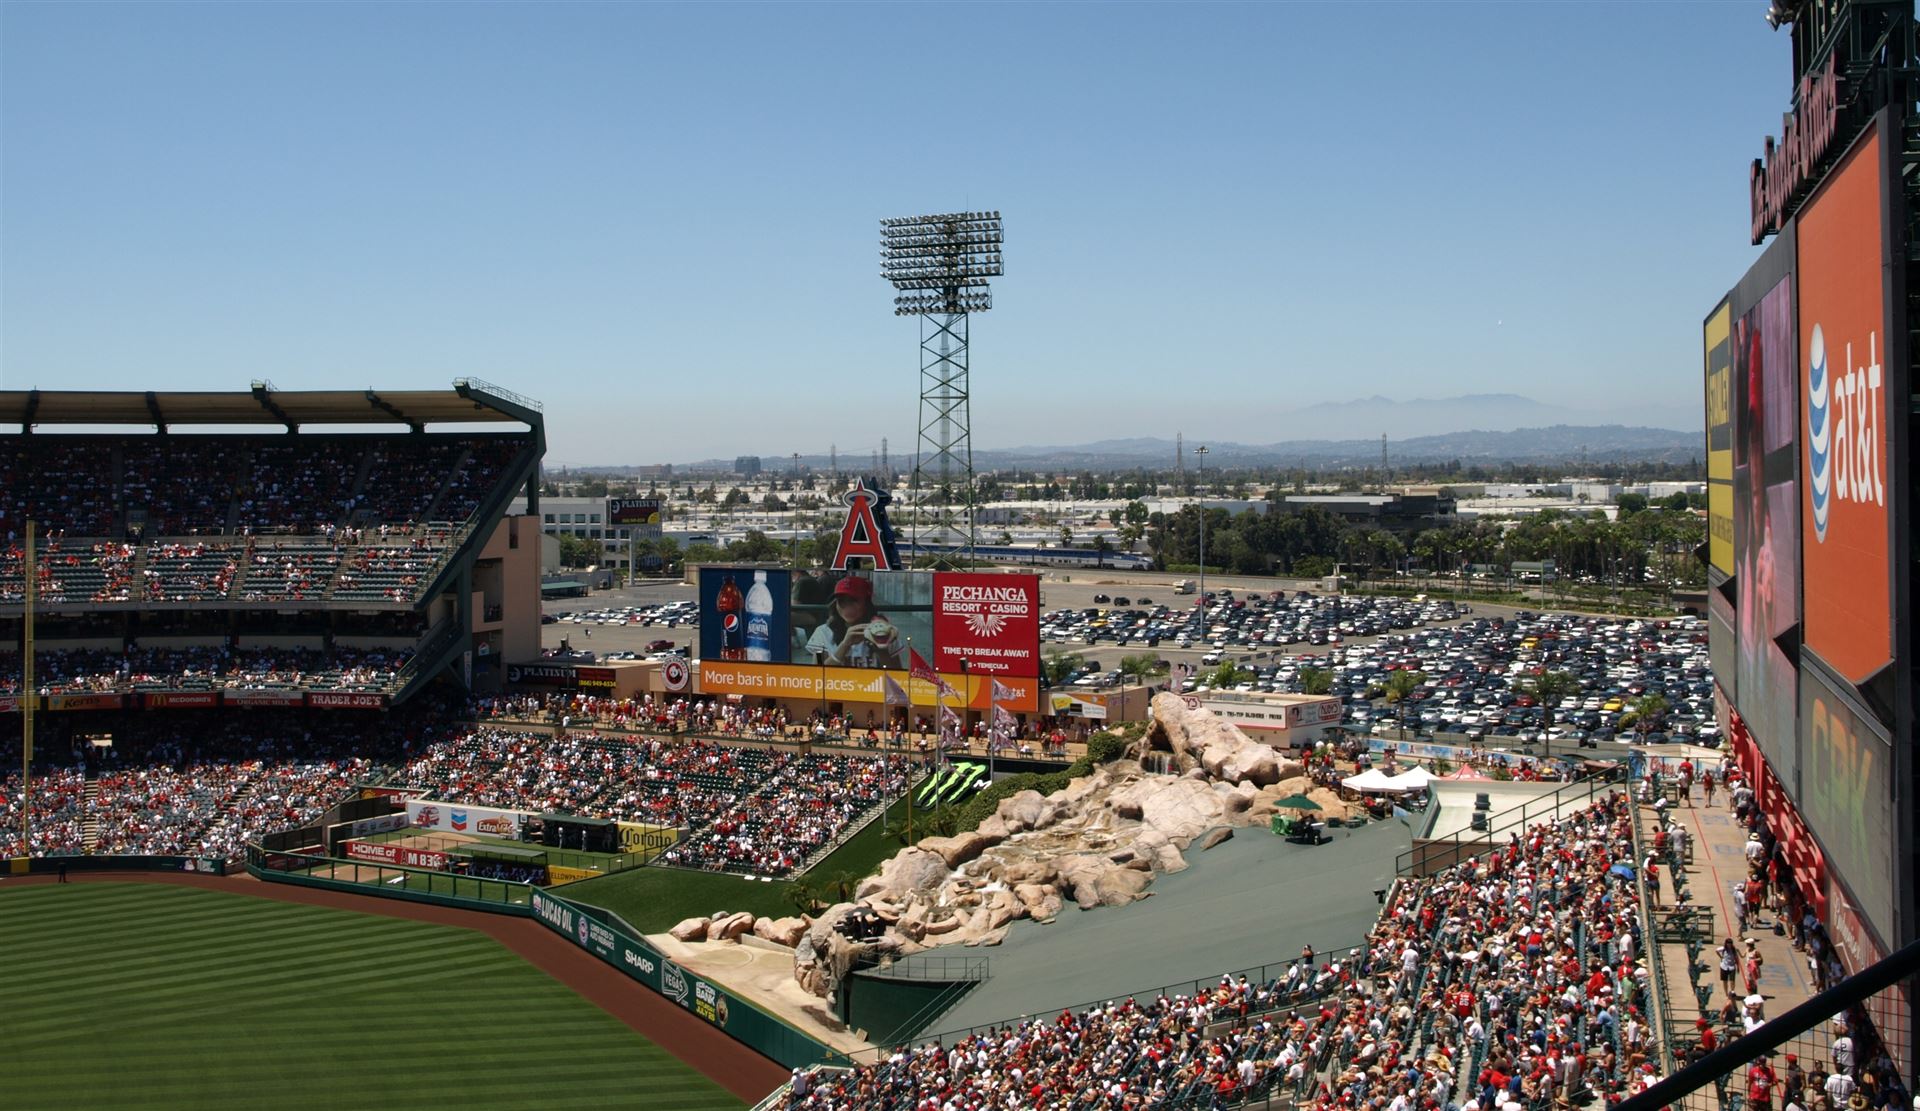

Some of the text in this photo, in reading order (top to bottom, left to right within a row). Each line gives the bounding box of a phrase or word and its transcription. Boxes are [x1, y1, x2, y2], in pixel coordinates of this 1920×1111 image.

[1835, 331, 1883, 507] at&t
[943, 586, 1029, 601] PECHANGA
[943, 603, 1028, 613] RESORT CASINO
[943, 646, 1029, 658] TIME TO BREAK AWAY!
[524, 667, 577, 678] PLATINUM
[977, 662, 1009, 670] TEMECULA
[705, 670, 854, 692] More bars in more paces
[312, 694, 381, 706] TRADER JOE'S
[1812, 698, 1873, 896] CPK
[621, 827, 672, 848] Corona
[352, 843, 385, 856] HOME
[385, 848, 397, 857] of
[541, 897, 573, 933] LUCAS OIL
[625, 949, 654, 974] SHARP
[665, 973, 684, 992] VEGAS
[696, 987, 715, 1007] BANK
